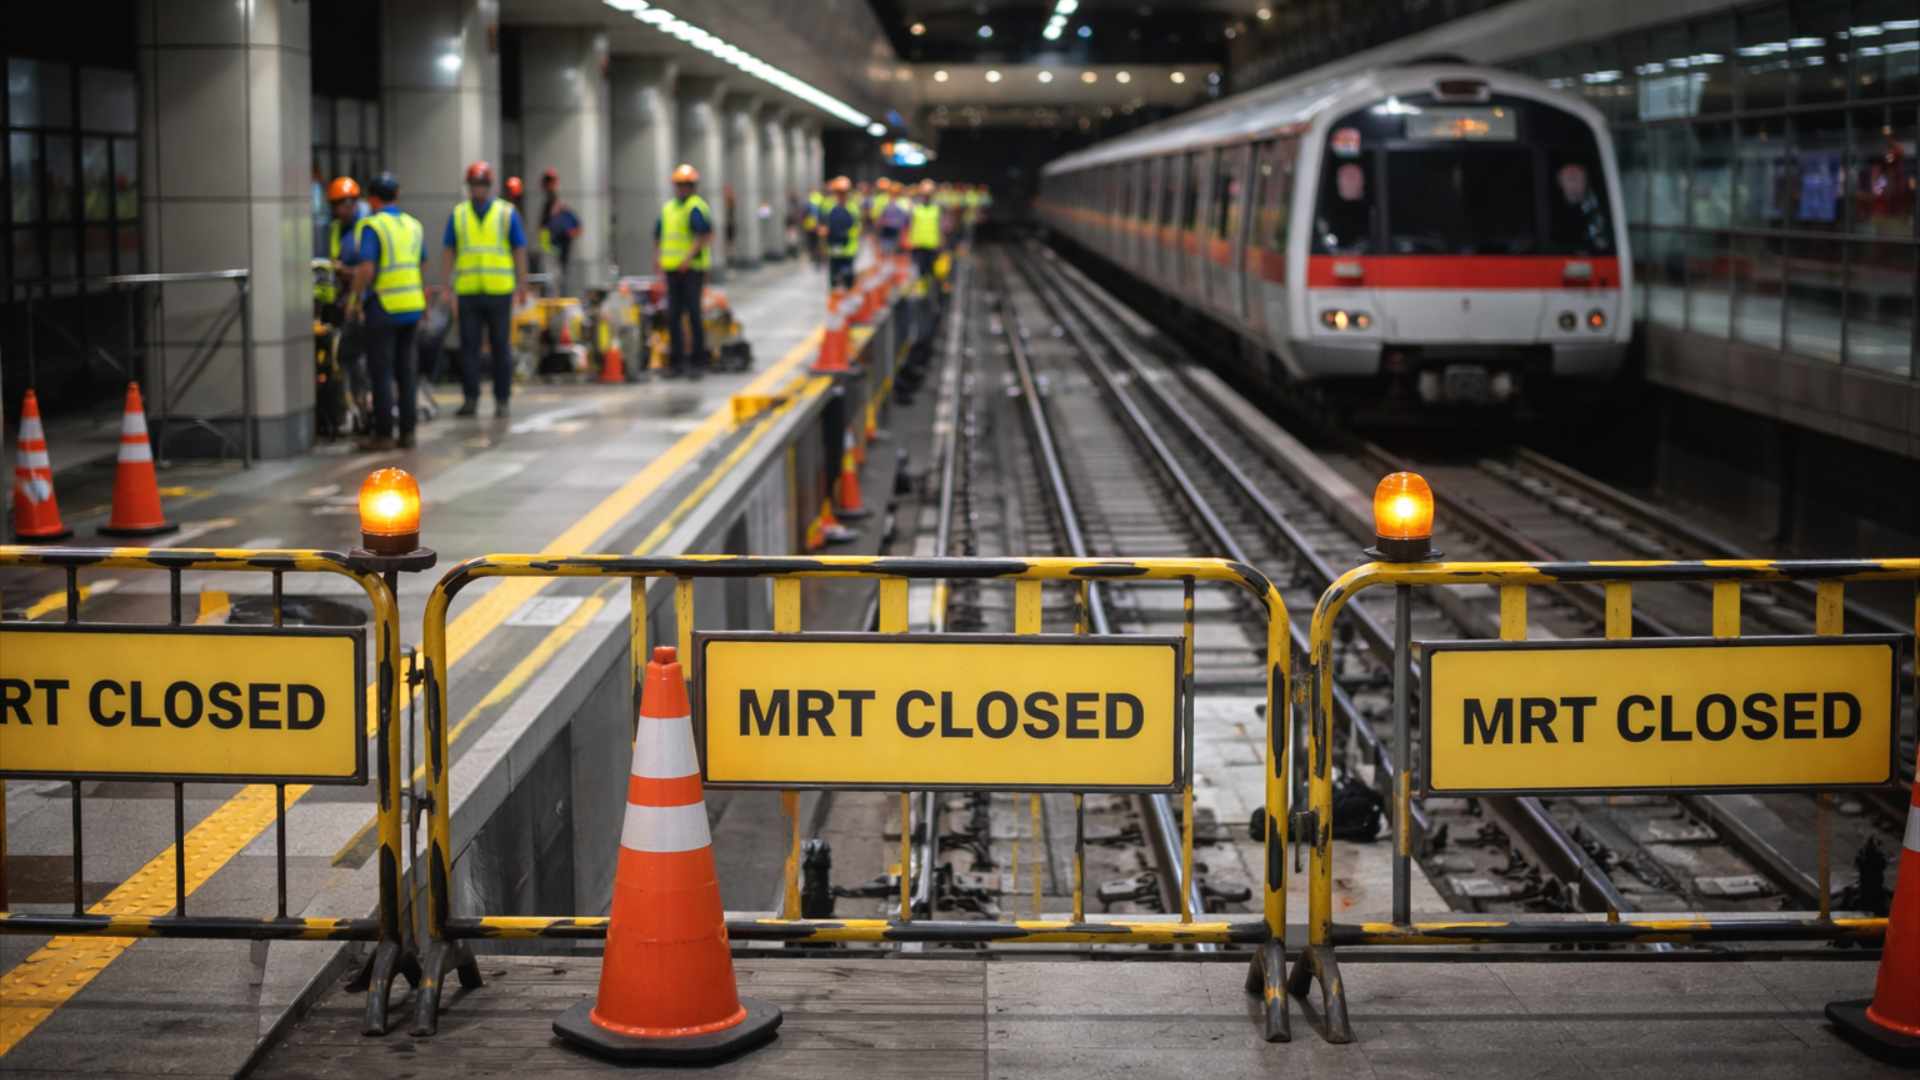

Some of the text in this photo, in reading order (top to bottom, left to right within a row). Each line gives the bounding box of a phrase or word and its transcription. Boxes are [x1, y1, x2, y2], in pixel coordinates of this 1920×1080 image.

[0, 677, 326, 731] RT CLOSED
[739, 689, 1144, 739] MRT CLOSED
[1463, 691, 1863, 745] MRT CLOSED
